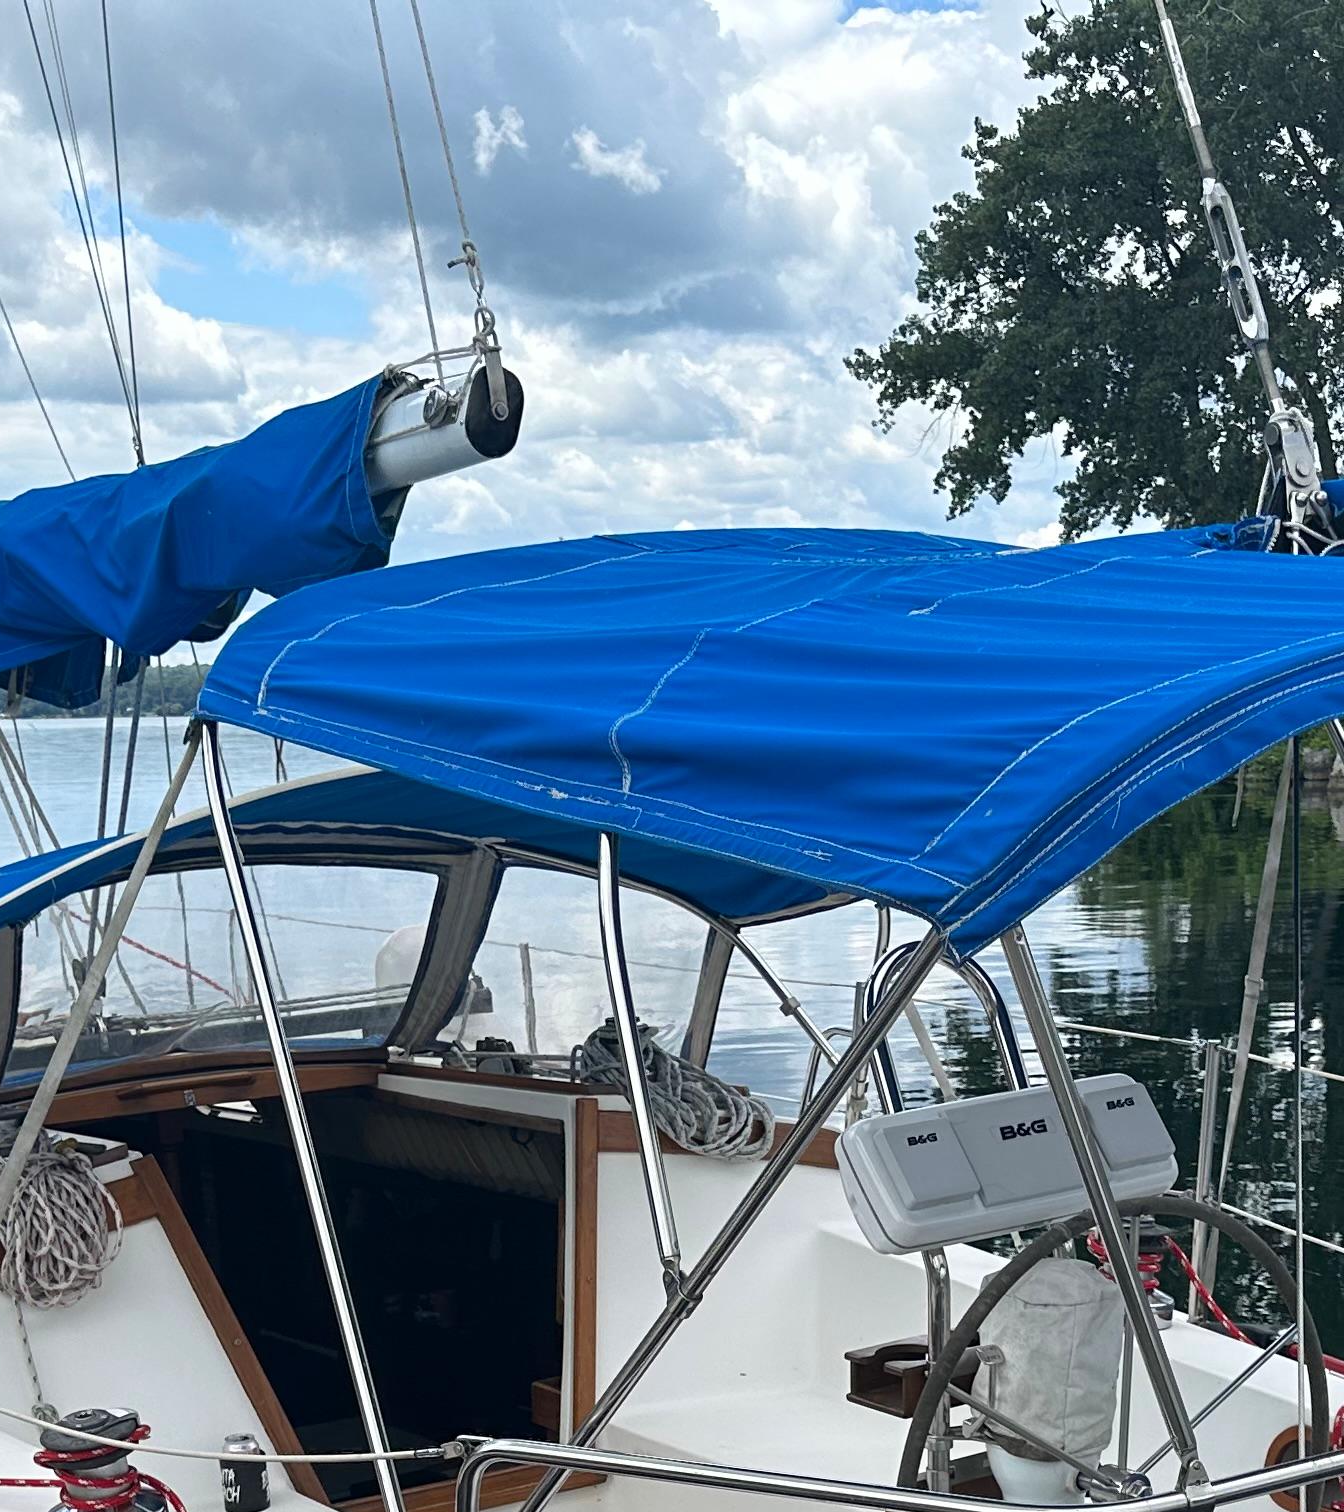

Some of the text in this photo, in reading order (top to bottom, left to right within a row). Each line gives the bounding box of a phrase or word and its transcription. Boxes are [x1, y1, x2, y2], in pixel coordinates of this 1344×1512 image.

[1106, 1097, 1135, 1111] B&G
[999, 1119, 1048, 1141] B&G
[907, 1132, 938, 1146] B&G
